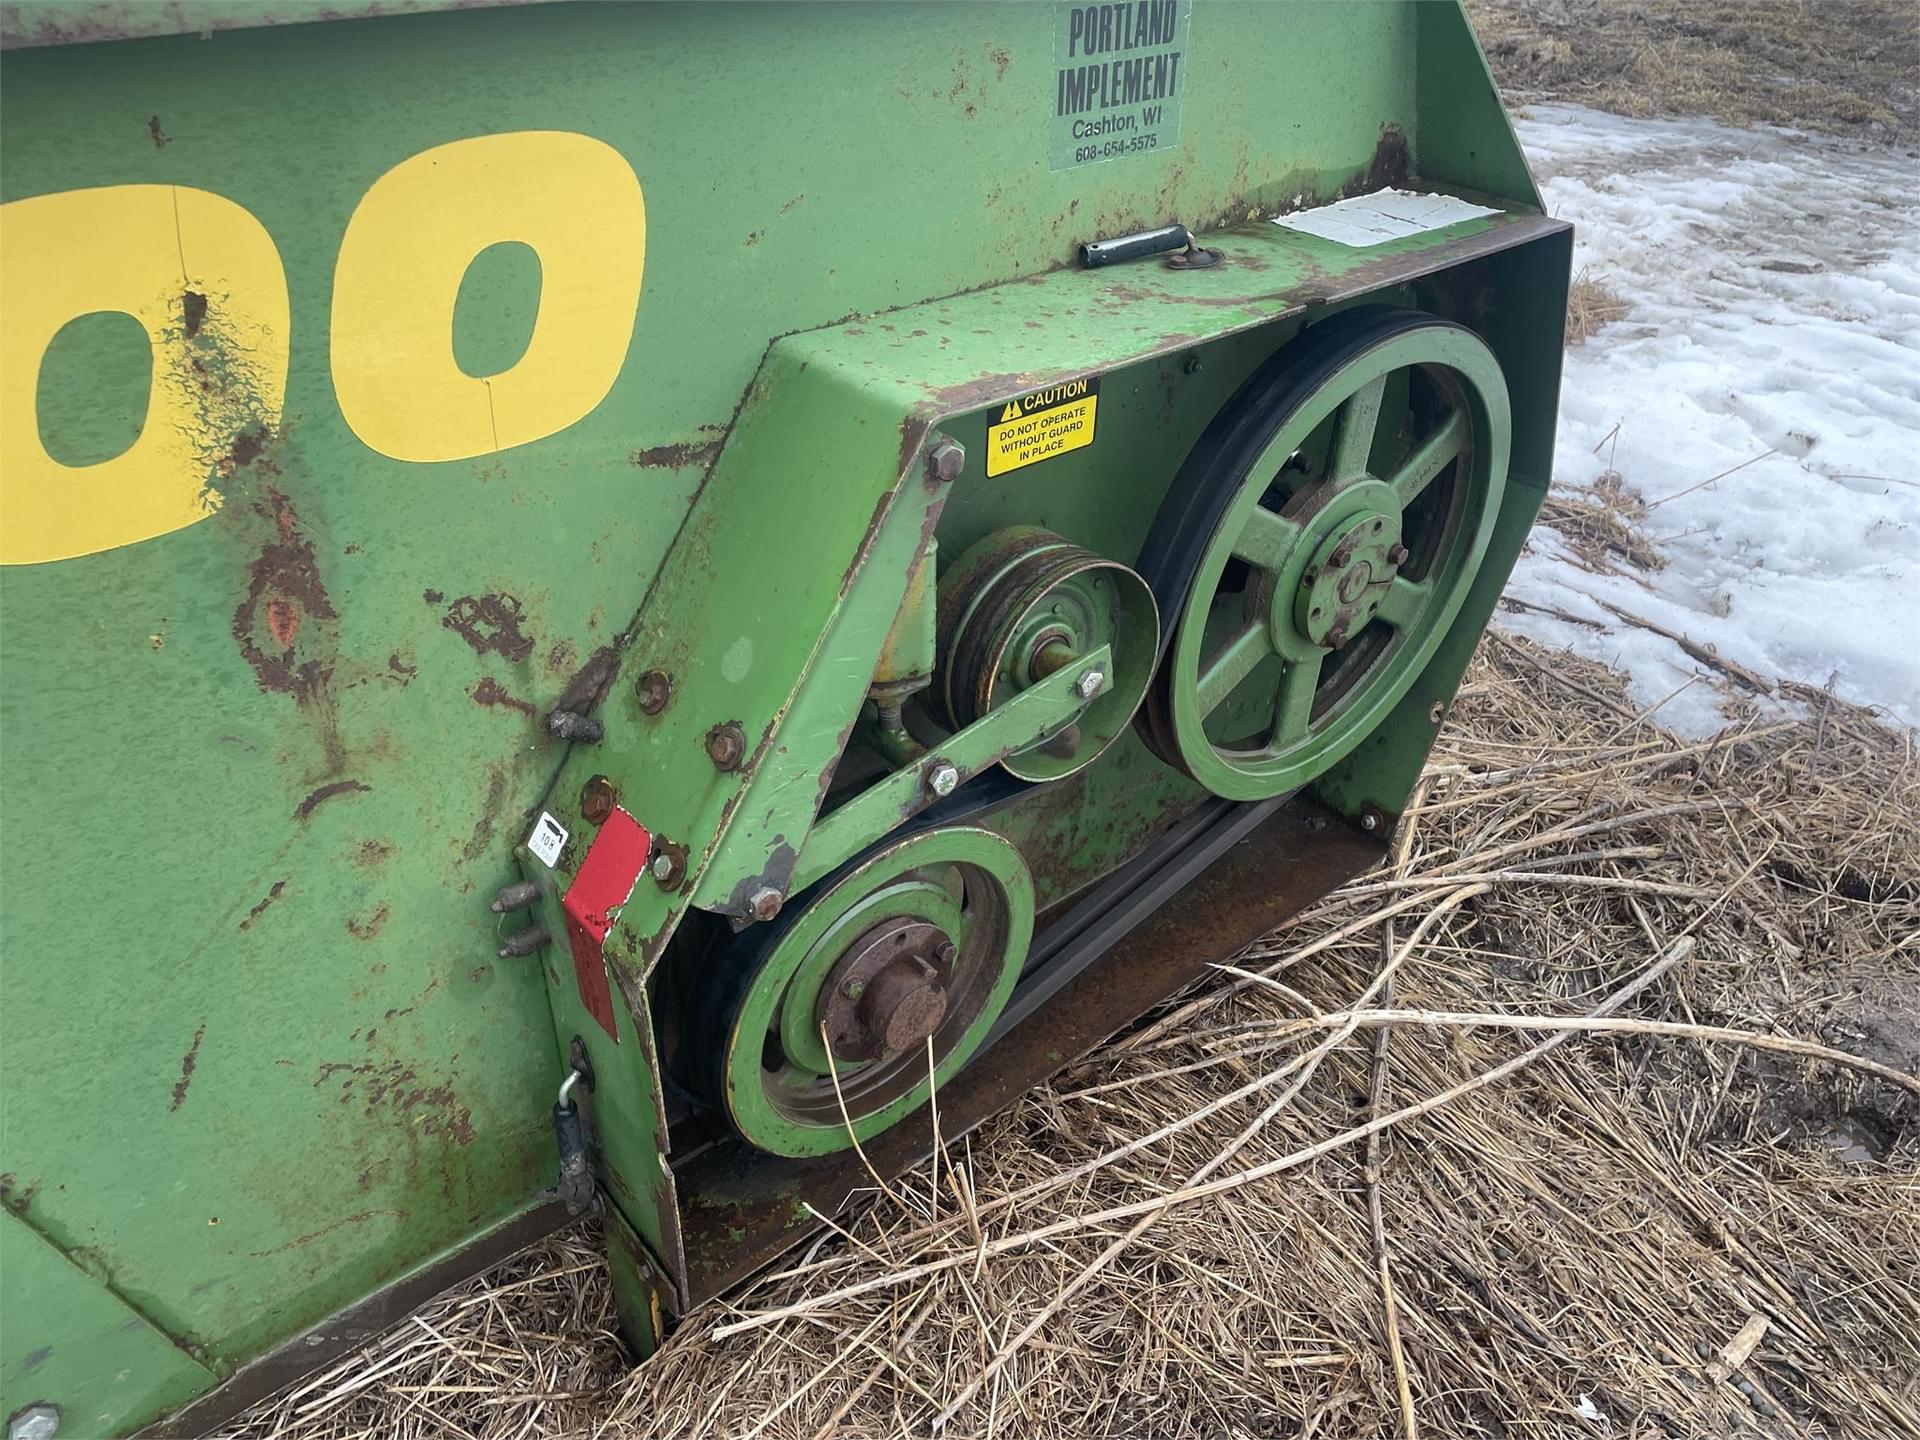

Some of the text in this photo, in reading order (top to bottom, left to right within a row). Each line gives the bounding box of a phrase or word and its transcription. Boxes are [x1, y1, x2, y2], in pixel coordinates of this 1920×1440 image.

[1069, 0, 1177, 58] PORTLAND
[1057, 52, 1181, 116] IMPLEMENT
[1072, 106, 1162, 139] Cashton, WI
[1075, 133, 1158, 162] 608-654-5575
[1024, 379, 1088, 410] CAUTION
[1000, 407, 1086, 441] DO NOT OPERATE
[1001, 420, 1084, 454] WITHOUT GUARD
[1019, 439, 1064, 461] IN PLACE
